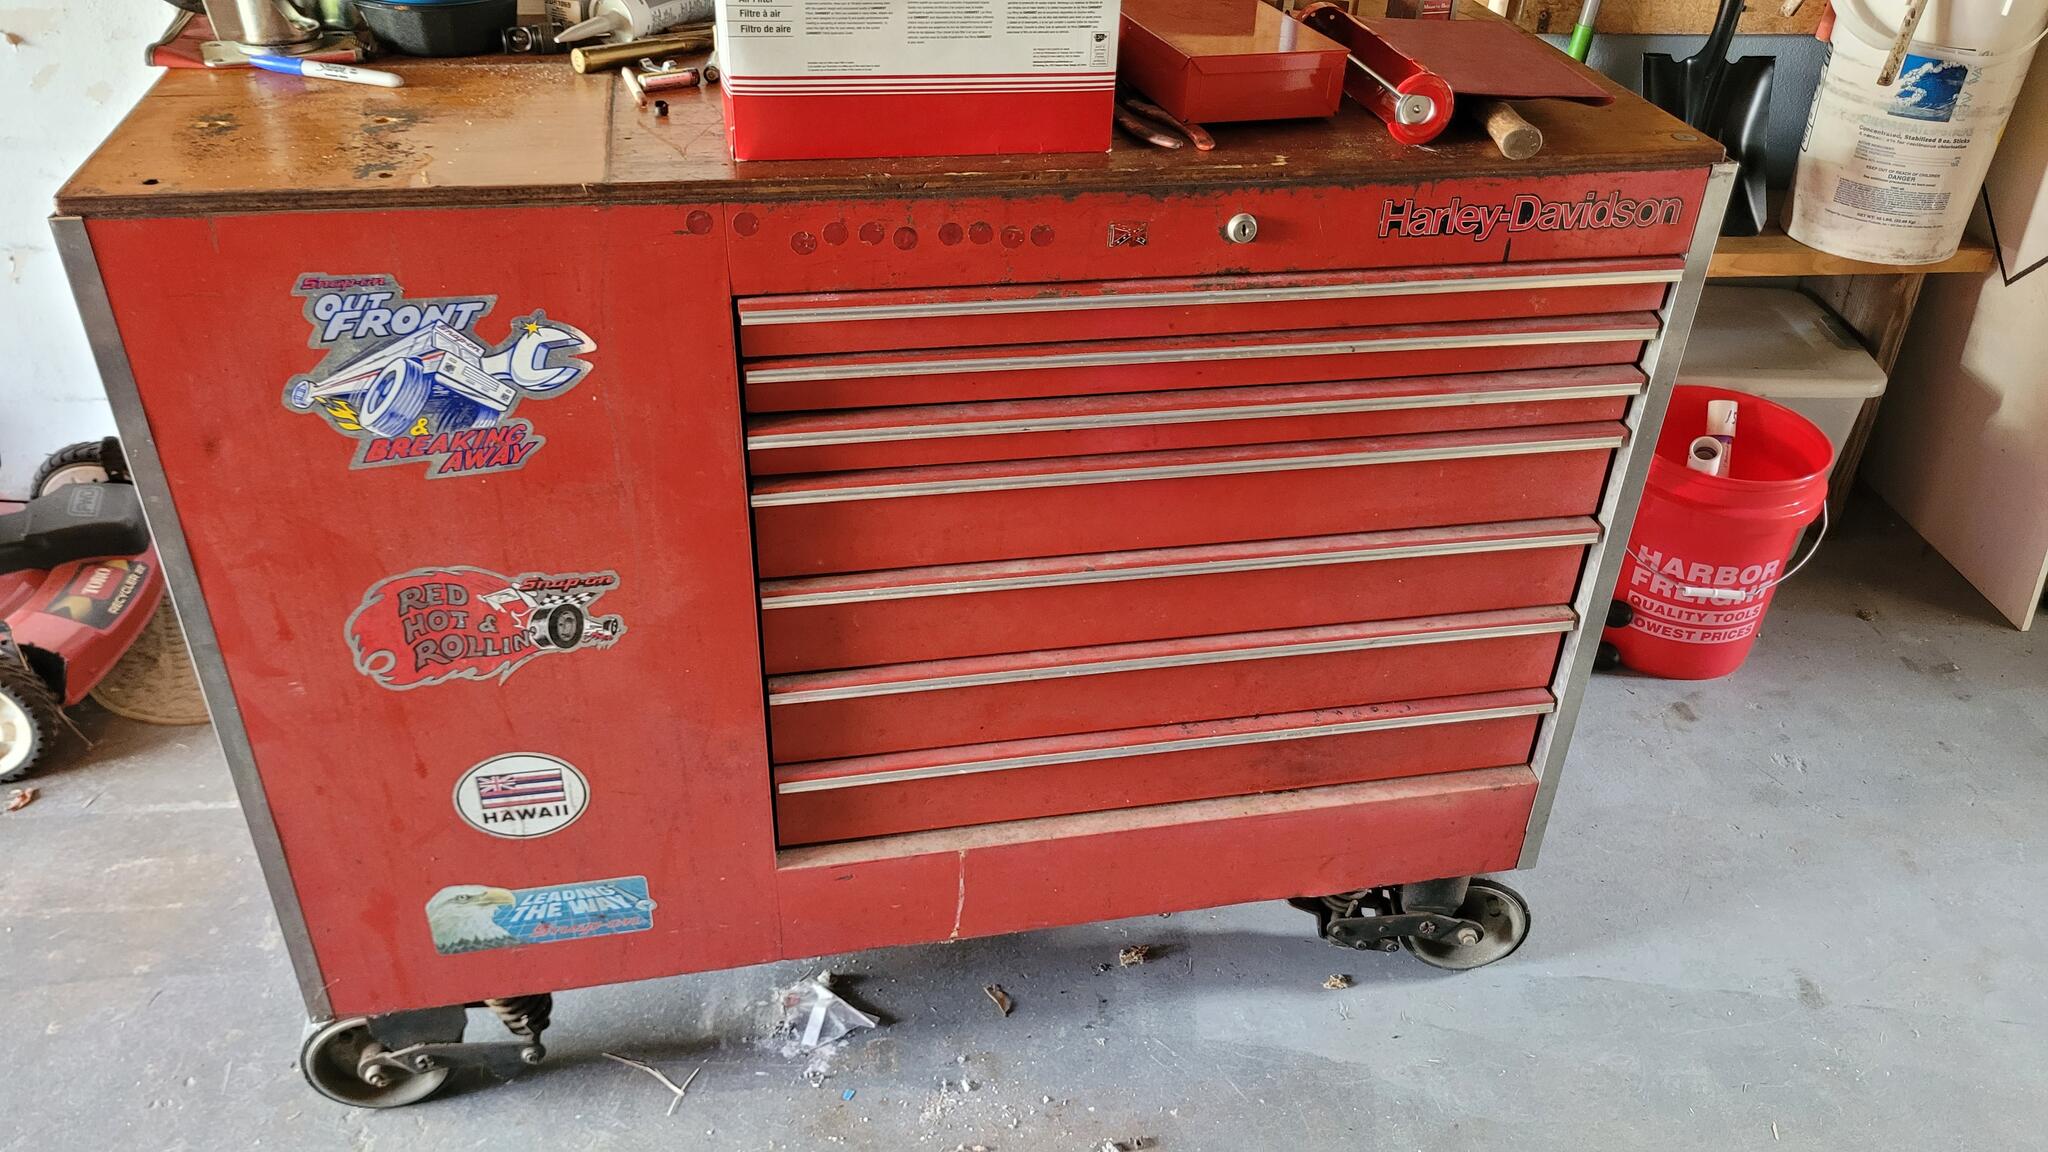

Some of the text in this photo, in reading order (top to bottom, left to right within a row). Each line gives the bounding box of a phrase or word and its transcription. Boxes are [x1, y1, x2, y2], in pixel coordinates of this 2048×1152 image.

[739, 9, 781, 17] Filtre à air
[740, 25, 791, 33] Filtro de aire
[1888, 174, 1916, 182] DANGER
[1378, 190, 1682, 242] Harley-Davidson
[314, 291, 394, 321] OUT
[321, 301, 487, 342] FRONT
[410, 418, 430, 436] &
[364, 424, 528, 463] BREAKING
[438, 441, 537, 474] AWAY
[1636, 545, 1780, 585] HARBOR
[519, 575, 614, 593] Snap-on
[398, 583, 469, 617] RED
[1630, 594, 1760, 623] QUALITY TOOLS
[403, 610, 500, 645] HOT &
[1630, 617, 1752, 641] OWEST PRICES
[483, 805, 569, 824] HAWAII
[520, 885, 616, 906] LEADING
[511, 902, 562, 921] THE
